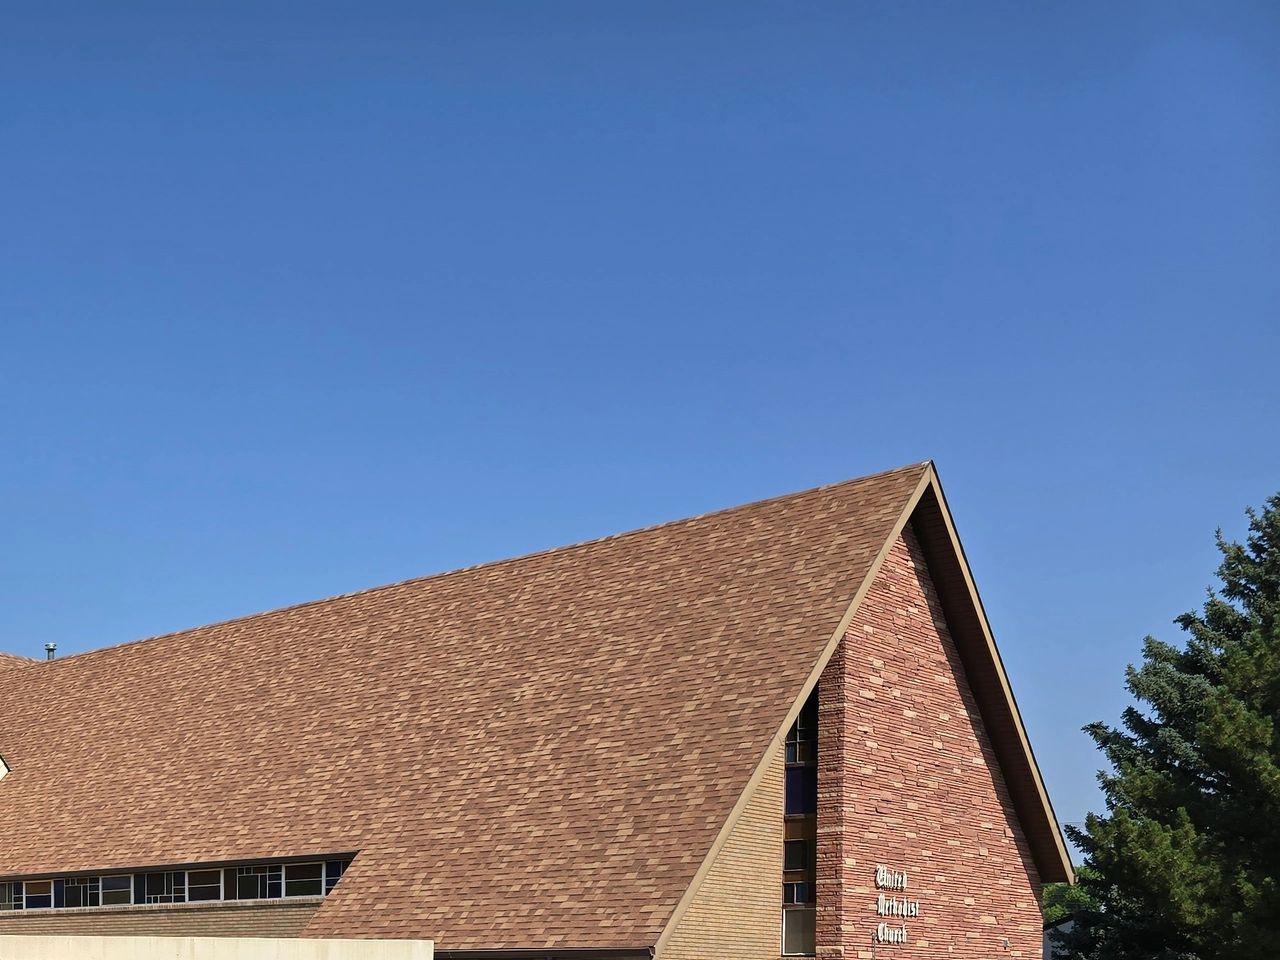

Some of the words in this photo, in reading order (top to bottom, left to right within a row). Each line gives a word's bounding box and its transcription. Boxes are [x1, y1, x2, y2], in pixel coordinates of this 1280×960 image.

[875, 863, 907, 888] United
[877, 893, 919, 918] Methodist
[876, 922, 907, 943] Church
